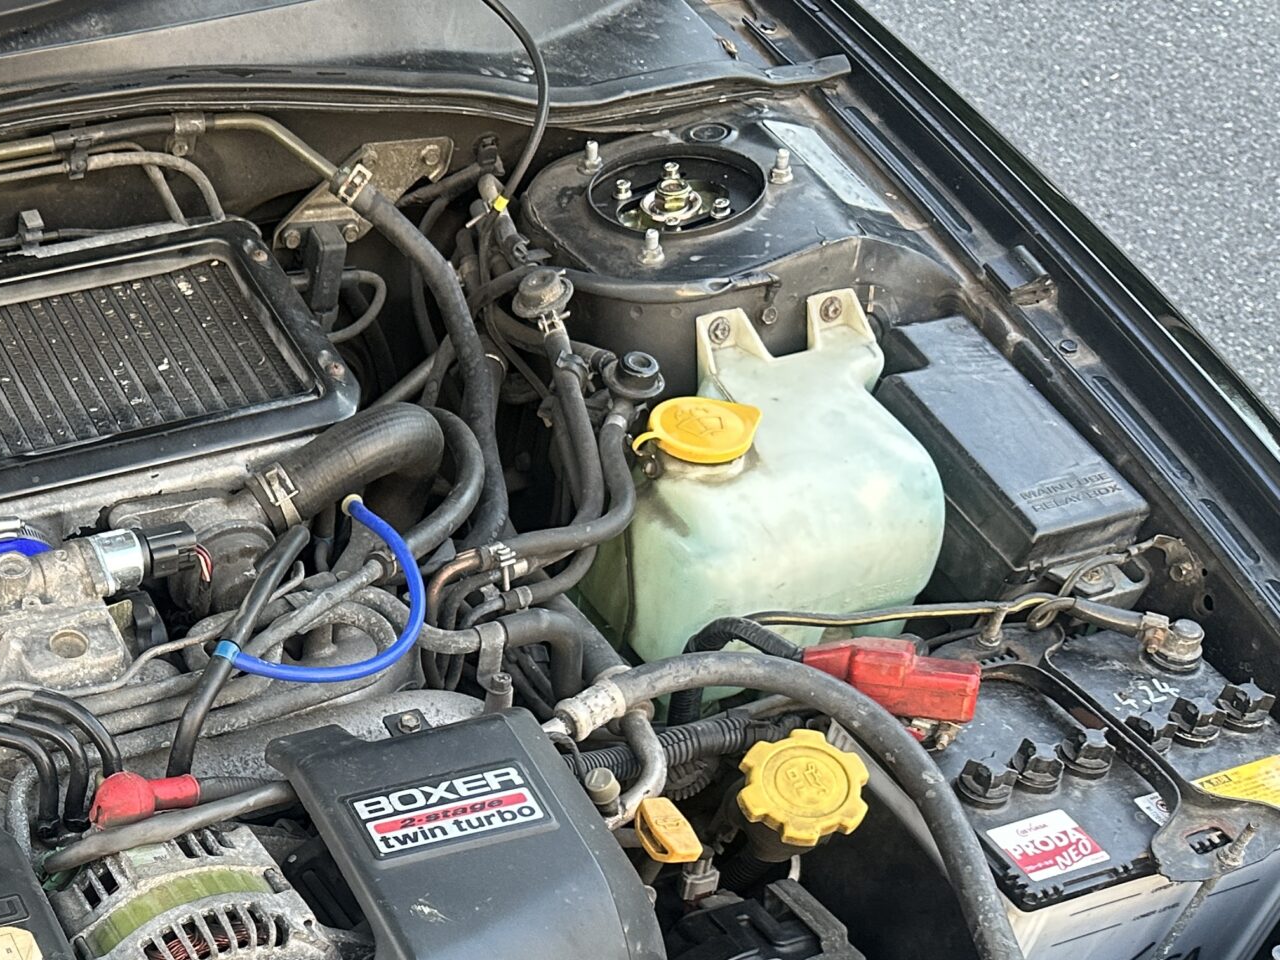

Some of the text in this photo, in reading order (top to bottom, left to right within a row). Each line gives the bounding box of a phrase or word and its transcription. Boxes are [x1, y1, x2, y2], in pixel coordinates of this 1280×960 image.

[1020, 481, 1066, 500] MAIN
[1032, 483, 1123, 512] RELAY BOX
[353, 767, 525, 820] BOXER
[379, 805, 536, 849] twin turbo
[1011, 827, 1087, 860] PRODA
[1055, 839, 1092, 871] NEO
